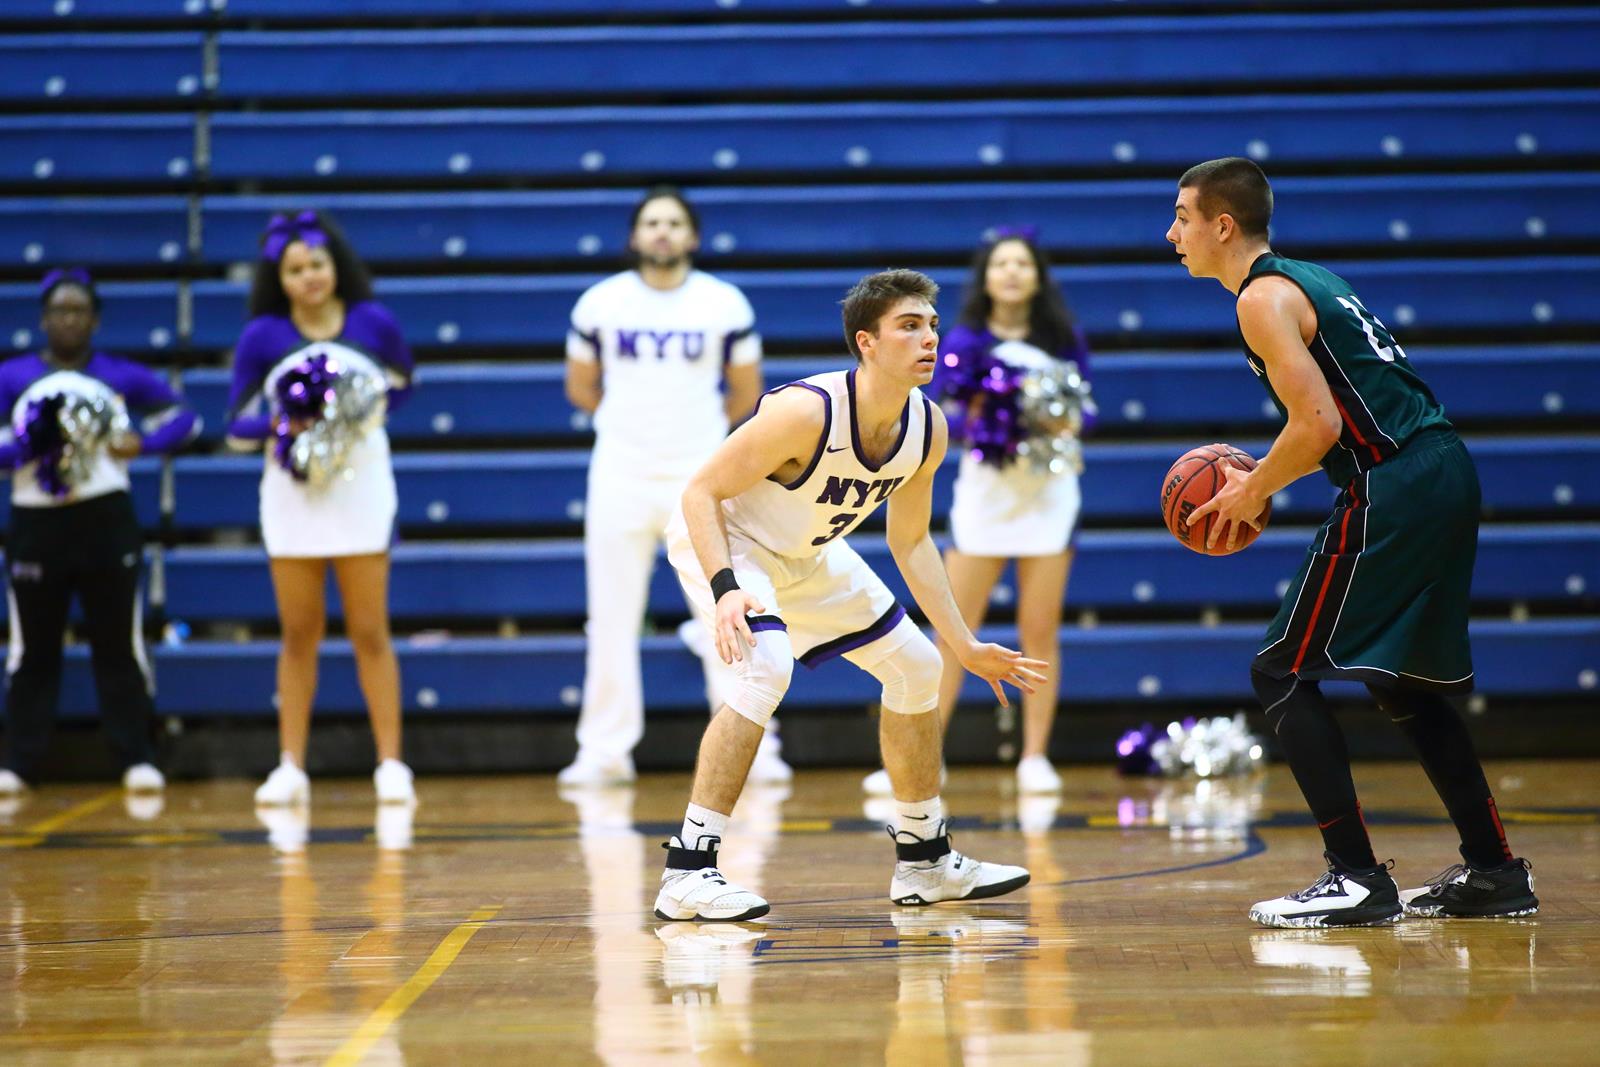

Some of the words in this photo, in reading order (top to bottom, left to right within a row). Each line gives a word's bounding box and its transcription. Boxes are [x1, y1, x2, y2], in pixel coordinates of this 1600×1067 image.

[617, 329, 704, 360] NYU
[815, 475, 905, 508] NYU
[811, 513, 858, 546] 3
